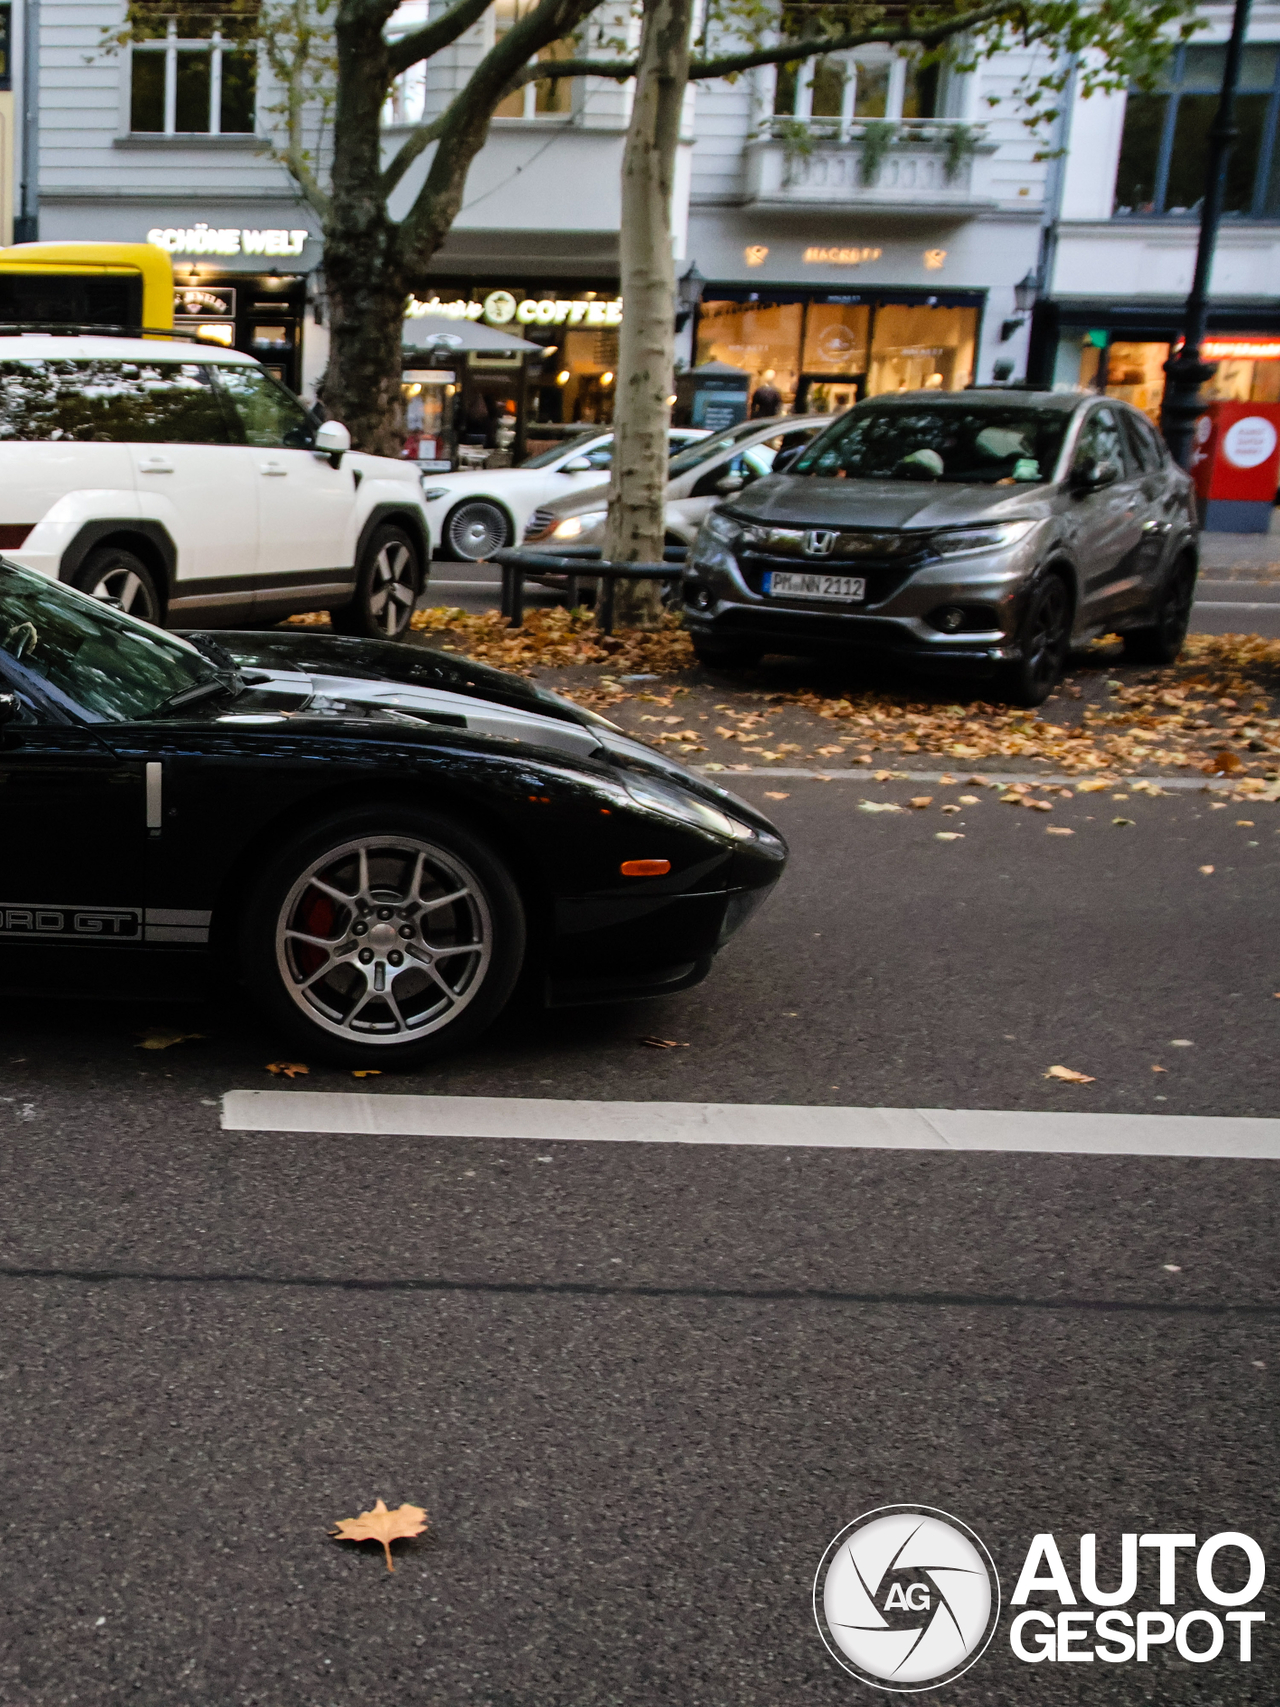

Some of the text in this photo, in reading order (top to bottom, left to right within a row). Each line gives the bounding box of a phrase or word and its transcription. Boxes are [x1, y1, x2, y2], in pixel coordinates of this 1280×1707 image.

[147, 223, 308, 256] SCHÖNE WELT
[516, 299, 623, 325] COFFEE
[823, 577, 862, 596] 2112
[74, 912, 132, 933] GT
